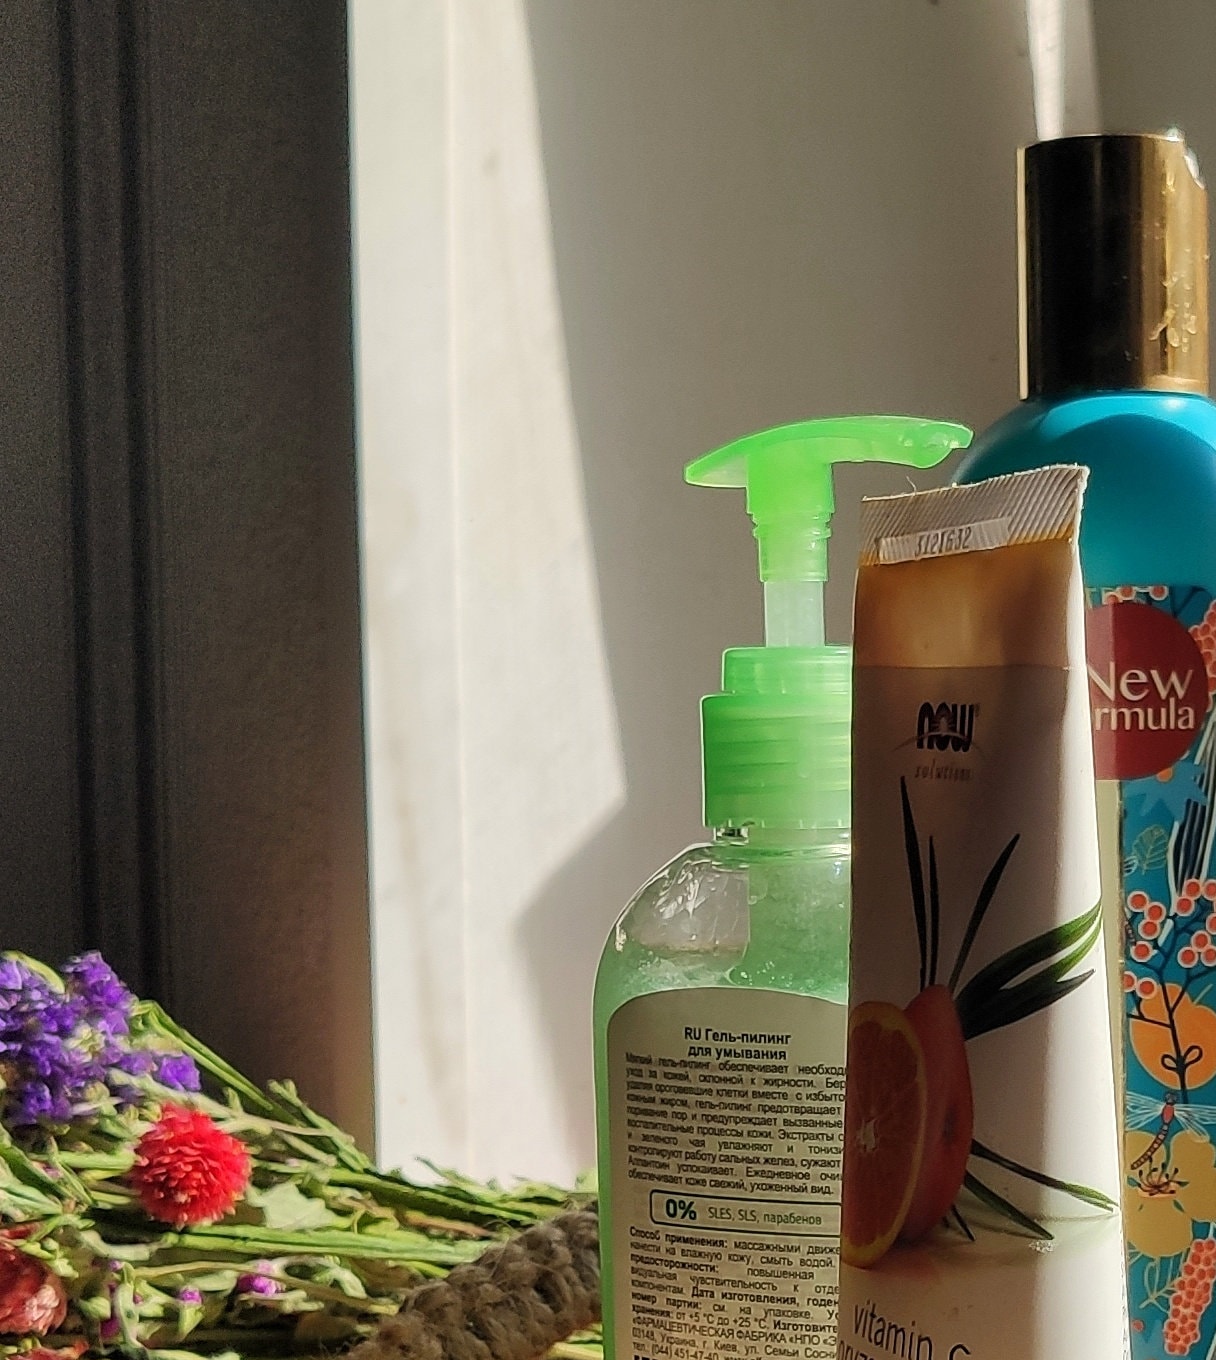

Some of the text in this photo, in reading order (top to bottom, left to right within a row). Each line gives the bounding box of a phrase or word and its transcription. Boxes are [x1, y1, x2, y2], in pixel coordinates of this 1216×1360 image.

[1088, 661, 1194, 702] New
[684, 1026, 791, 1045] RU Гель-пилинг
[688, 1046, 786, 1060] для умывания
[719, 1060, 789, 1074] обеспечивает
[698, 1074, 743, 1085] склонной
[751, 1077, 756, 1085] к
[763, 1078, 816, 1088] жирности.
[716, 1088, 748, 1098] клетки
[752, 1090, 788, 1101] вместе
[695, 1100, 752, 1111] гель-пилинг
[758, 1103, 841, 1116] предотвращает
[671, 1111, 688, 1122] пор
[702, 1114, 777, 1126] предупреждает
[783, 1118, 843, 1128] вызванные
[697, 1126, 743, 1138] процессы
[747, 1129, 774, 1139] кожи.
[778, 1129, 834, 1143] Экстракты
[689, 1138, 706, 1147] чая
[717, 1141, 773, 1152] увлажняют
[787, 1145, 793, 1153] и
[684, 1150, 716, 1164] работу
[719, 1154, 760, 1164] сальных
[763, 1157, 797, 1168] желез,
[800, 1159, 841, 1170] сужают
[677, 1163, 737, 1176] успокаивает.
[746, 1166, 810, 1181] Ежедневное
[685, 1177, 707, 1187] коже
[709, 1179, 747, 1191] свежий,
[750, 1181, 808, 1193] ухоженный
[810, 1185, 834, 1195] вид.
[665, 1198, 822, 1226] 0% SLES, SLS, парабенов
[629, 1225, 660, 1241] Способ
[665, 1233, 728, 1248] применения:
[733, 1241, 801, 1253] массажными
[665, 1246, 676, 1256] на
[681, 1248, 723, 1262] влажную
[727, 1253, 754, 1265] кожу,
[760, 1255, 793, 1266] смыть
[799, 1257, 836, 1268] водой.
[630, 1253, 815, 1280] предосторожности: повышенная
[689, 1275, 777, 1291] чувствительность
[794, 1284, 799, 1293] к
[631, 1292, 657, 1305] номер
[665, 1297, 702, 1310] партии:
[739, 1306, 751, 1315] на
[763, 1308, 814, 1319] упаковке.
[691, 1286, 715, 1298] Дата
[721, 1291, 800, 1307] изготовления,
[675, 1311, 686, 1320] от
[689, 1311, 700, 1323] +5
[716, 1316, 730, 1326] до
[732, 1316, 751, 1328] +25
[736, 1329, 787, 1343] ФАБРИКА
[651, 1343, 673, 1359] (044)
[661, 1333, 699, 1348] Украина,
[714, 1340, 740, 1354] Киев,
[744, 1345, 759, 1356] ул.
[764, 1344, 799, 1358] Семьи
